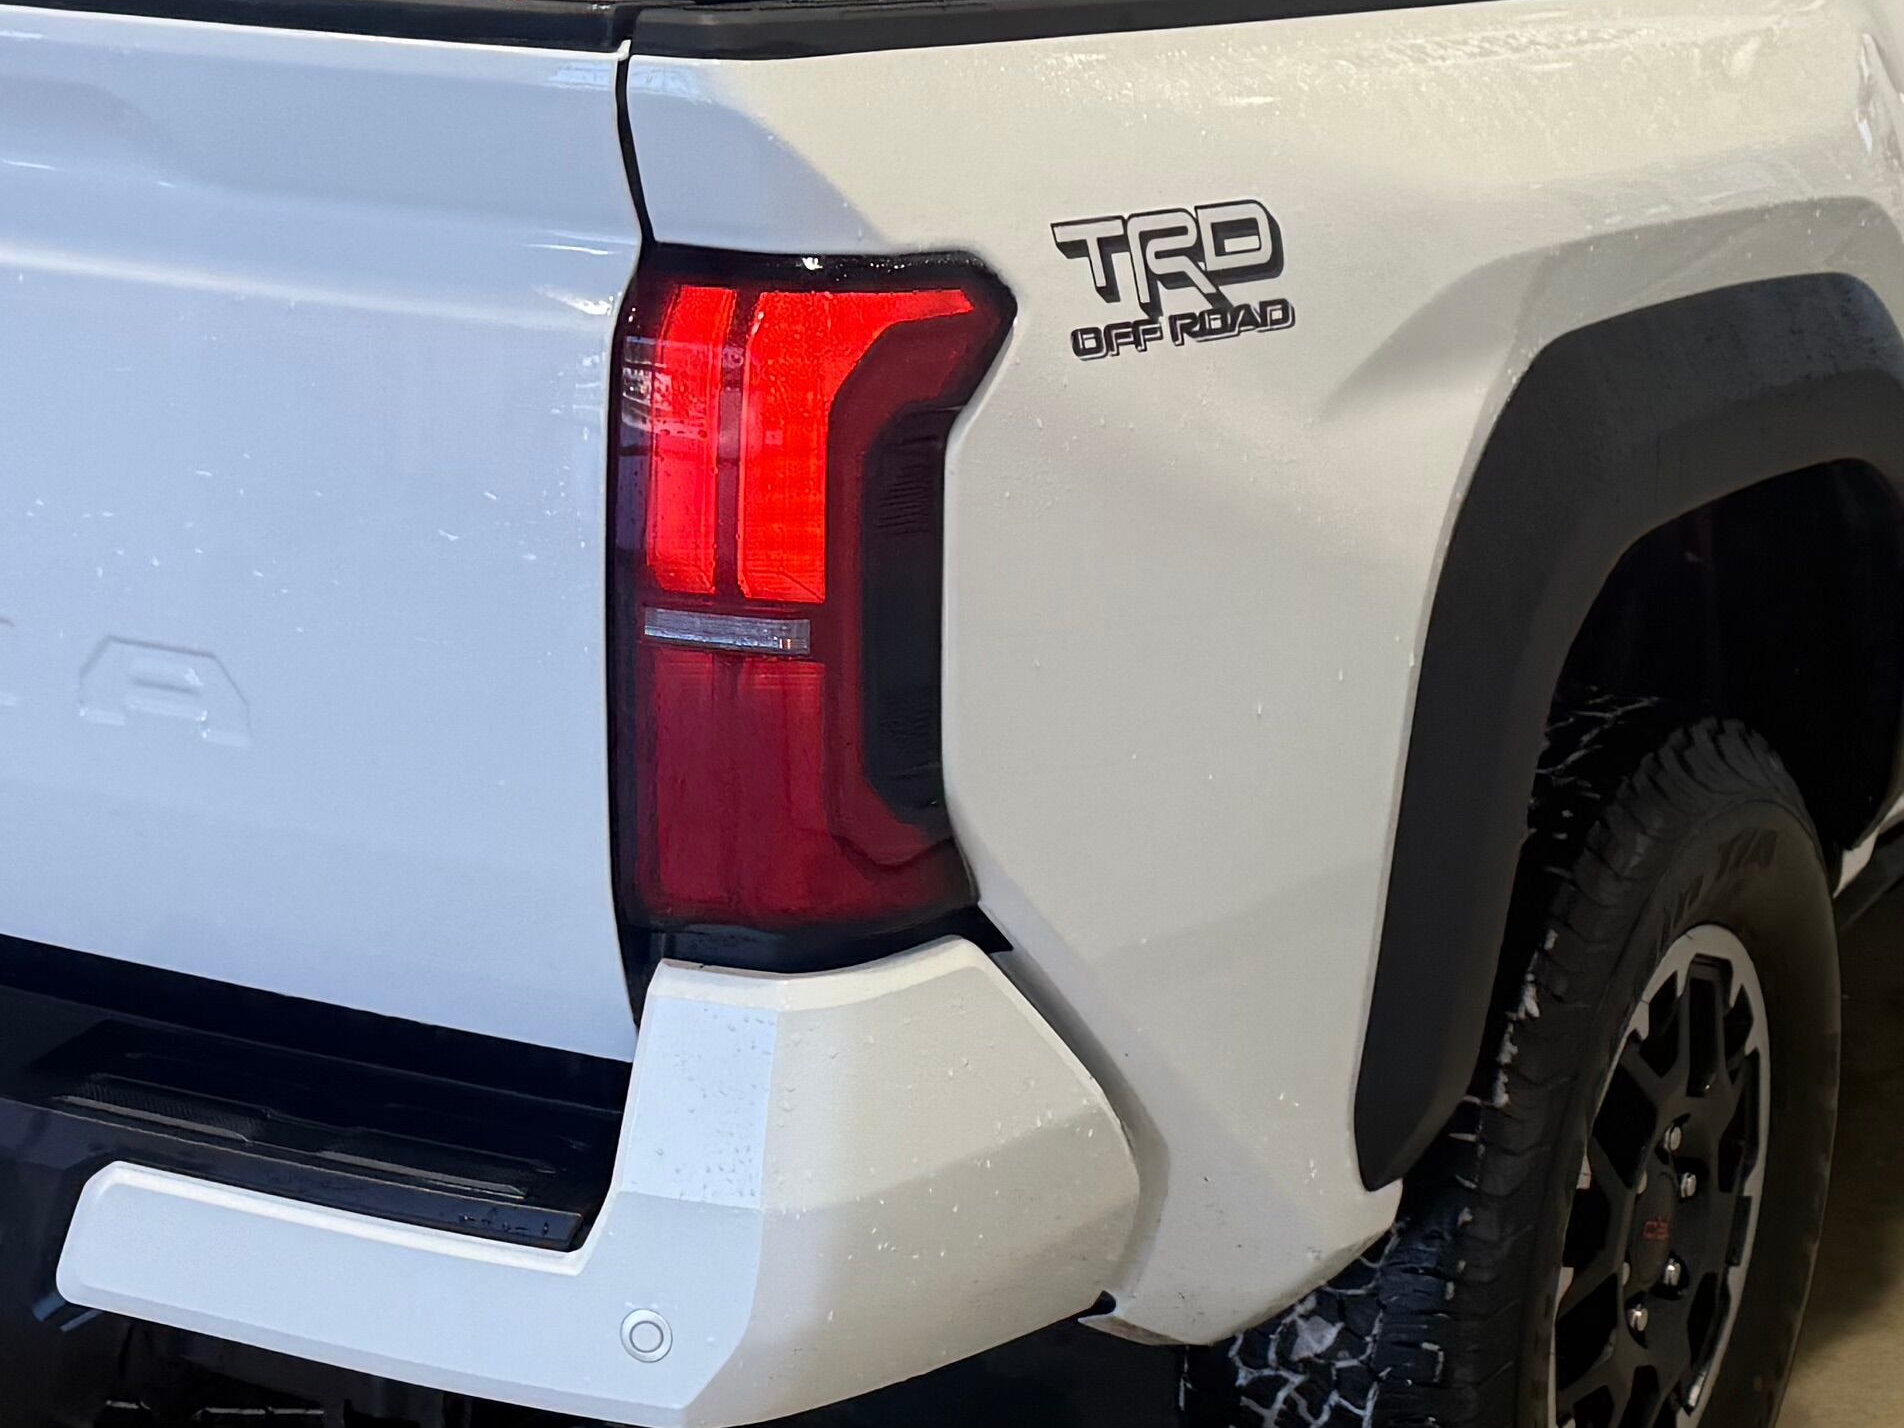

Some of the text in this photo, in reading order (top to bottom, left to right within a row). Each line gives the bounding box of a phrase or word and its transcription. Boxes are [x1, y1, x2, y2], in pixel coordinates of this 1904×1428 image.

[1050, 199, 1284, 319] TRD
[1070, 298, 1295, 361] OFF ROAD
